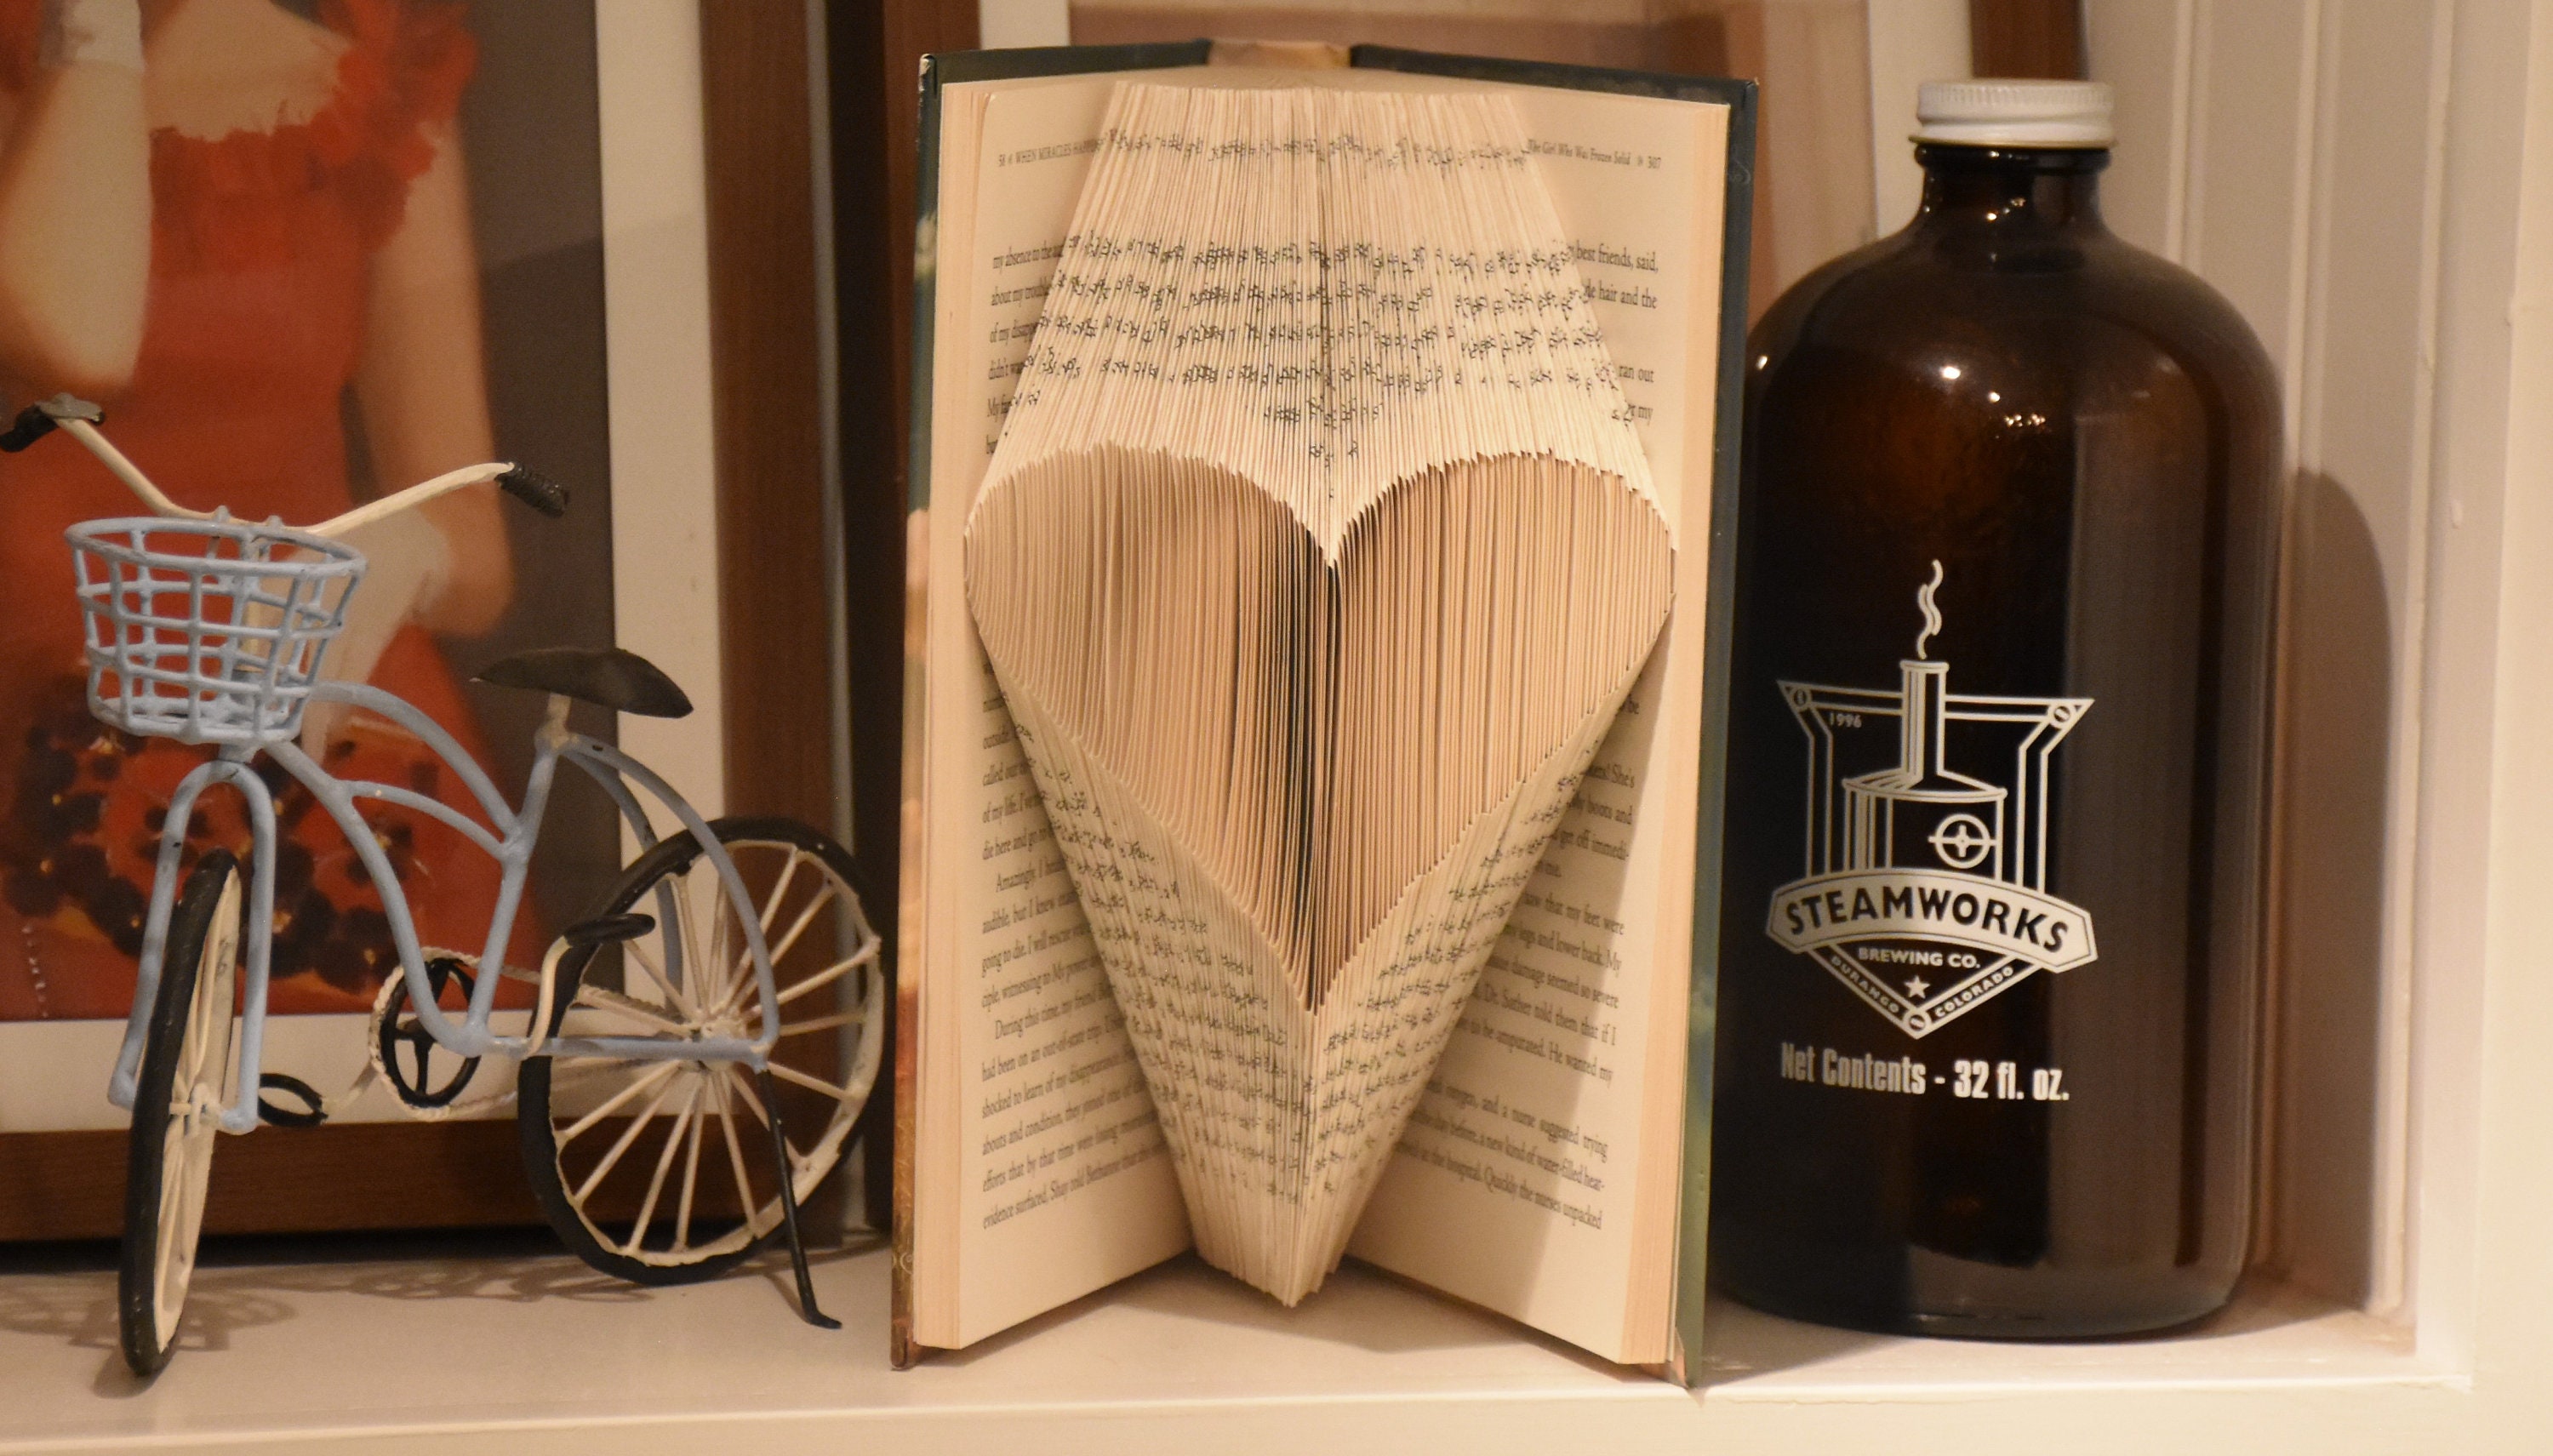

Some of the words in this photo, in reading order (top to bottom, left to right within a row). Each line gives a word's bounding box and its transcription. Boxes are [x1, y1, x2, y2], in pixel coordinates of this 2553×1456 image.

[1014, 148, 1037, 163] WHEN
[1541, 140, 1556, 155] Girl
[1557, 142, 1573, 157] Who
[1573, 145, 1588, 159] Was
[1590, 146, 1612, 162] Frozen
[1613, 150, 1631, 164] Solid
[1004, 247, 1031, 266] absence
[1575, 238, 1596, 261] best
[1597, 243, 1634, 271] friends,
[1635, 252, 1659, 276] said,
[990, 285, 1012, 305] about
[1597, 279, 1618, 301] hair
[1619, 285, 1639, 305] and
[1641, 288, 1659, 309] the
[1618, 364, 1635, 379] ran
[1637, 368, 1655, 383] out
[1637, 406, 1653, 426] my
[1829, 712, 1862, 728] 1996
[1614, 804, 1632, 825] and
[994, 835, 1011, 854] here
[1012, 826, 1028, 848] and
[1544, 894, 1563, 916] that
[1602, 917, 1625, 935] were
[1787, 886, 2069, 954] STEAMWORKS
[1536, 928, 1554, 950] and
[1555, 931, 1581, 958] lower
[1581, 939, 1605, 966] back.
[1859, 947, 1943, 967] BREWING
[1948, 953, 1981, 969] CO.
[981, 950, 1002, 978] going
[1546, 973, 1579, 995] seemed
[1591, 988, 1619, 1008] severe
[1831, 955, 1900, 1014] DURANGO
[1933, 965, 2014, 1019] COLORADO
[994, 1016, 1023, 1039] During
[1555, 1008, 1579, 1032] them
[1579, 1016, 1599, 1039] that
[981, 1059, 996, 1081] had
[997, 1056, 1016, 1075] been
[1564, 1053, 1596, 1076] wanted
[1781, 1042, 1815, 1082] Net
[1822, 1047, 1927, 1095] Contents
[1953, 1059, 1990, 1099] 32
[1996, 1061, 2025, 1100] fl.
[2032, 1068, 2070, 1101] oz.
[981, 1089, 1012, 1118] shocked
[1023, 1082, 1044, 1102] learn
[982, 1133, 1007, 1155] abouts
[1008, 1121, 1023, 1144] and
[1582, 1133, 1609, 1163] trying
[982, 1170, 1006, 1191] efforts
[1008, 1160, 1024, 1180] that
[1038, 1147, 1054, 1168] that
[983, 1204, 1014, 1228] evidence
[1518, 1179, 1534, 1202] the
[1562, 1203, 1603, 1230] unpacked
